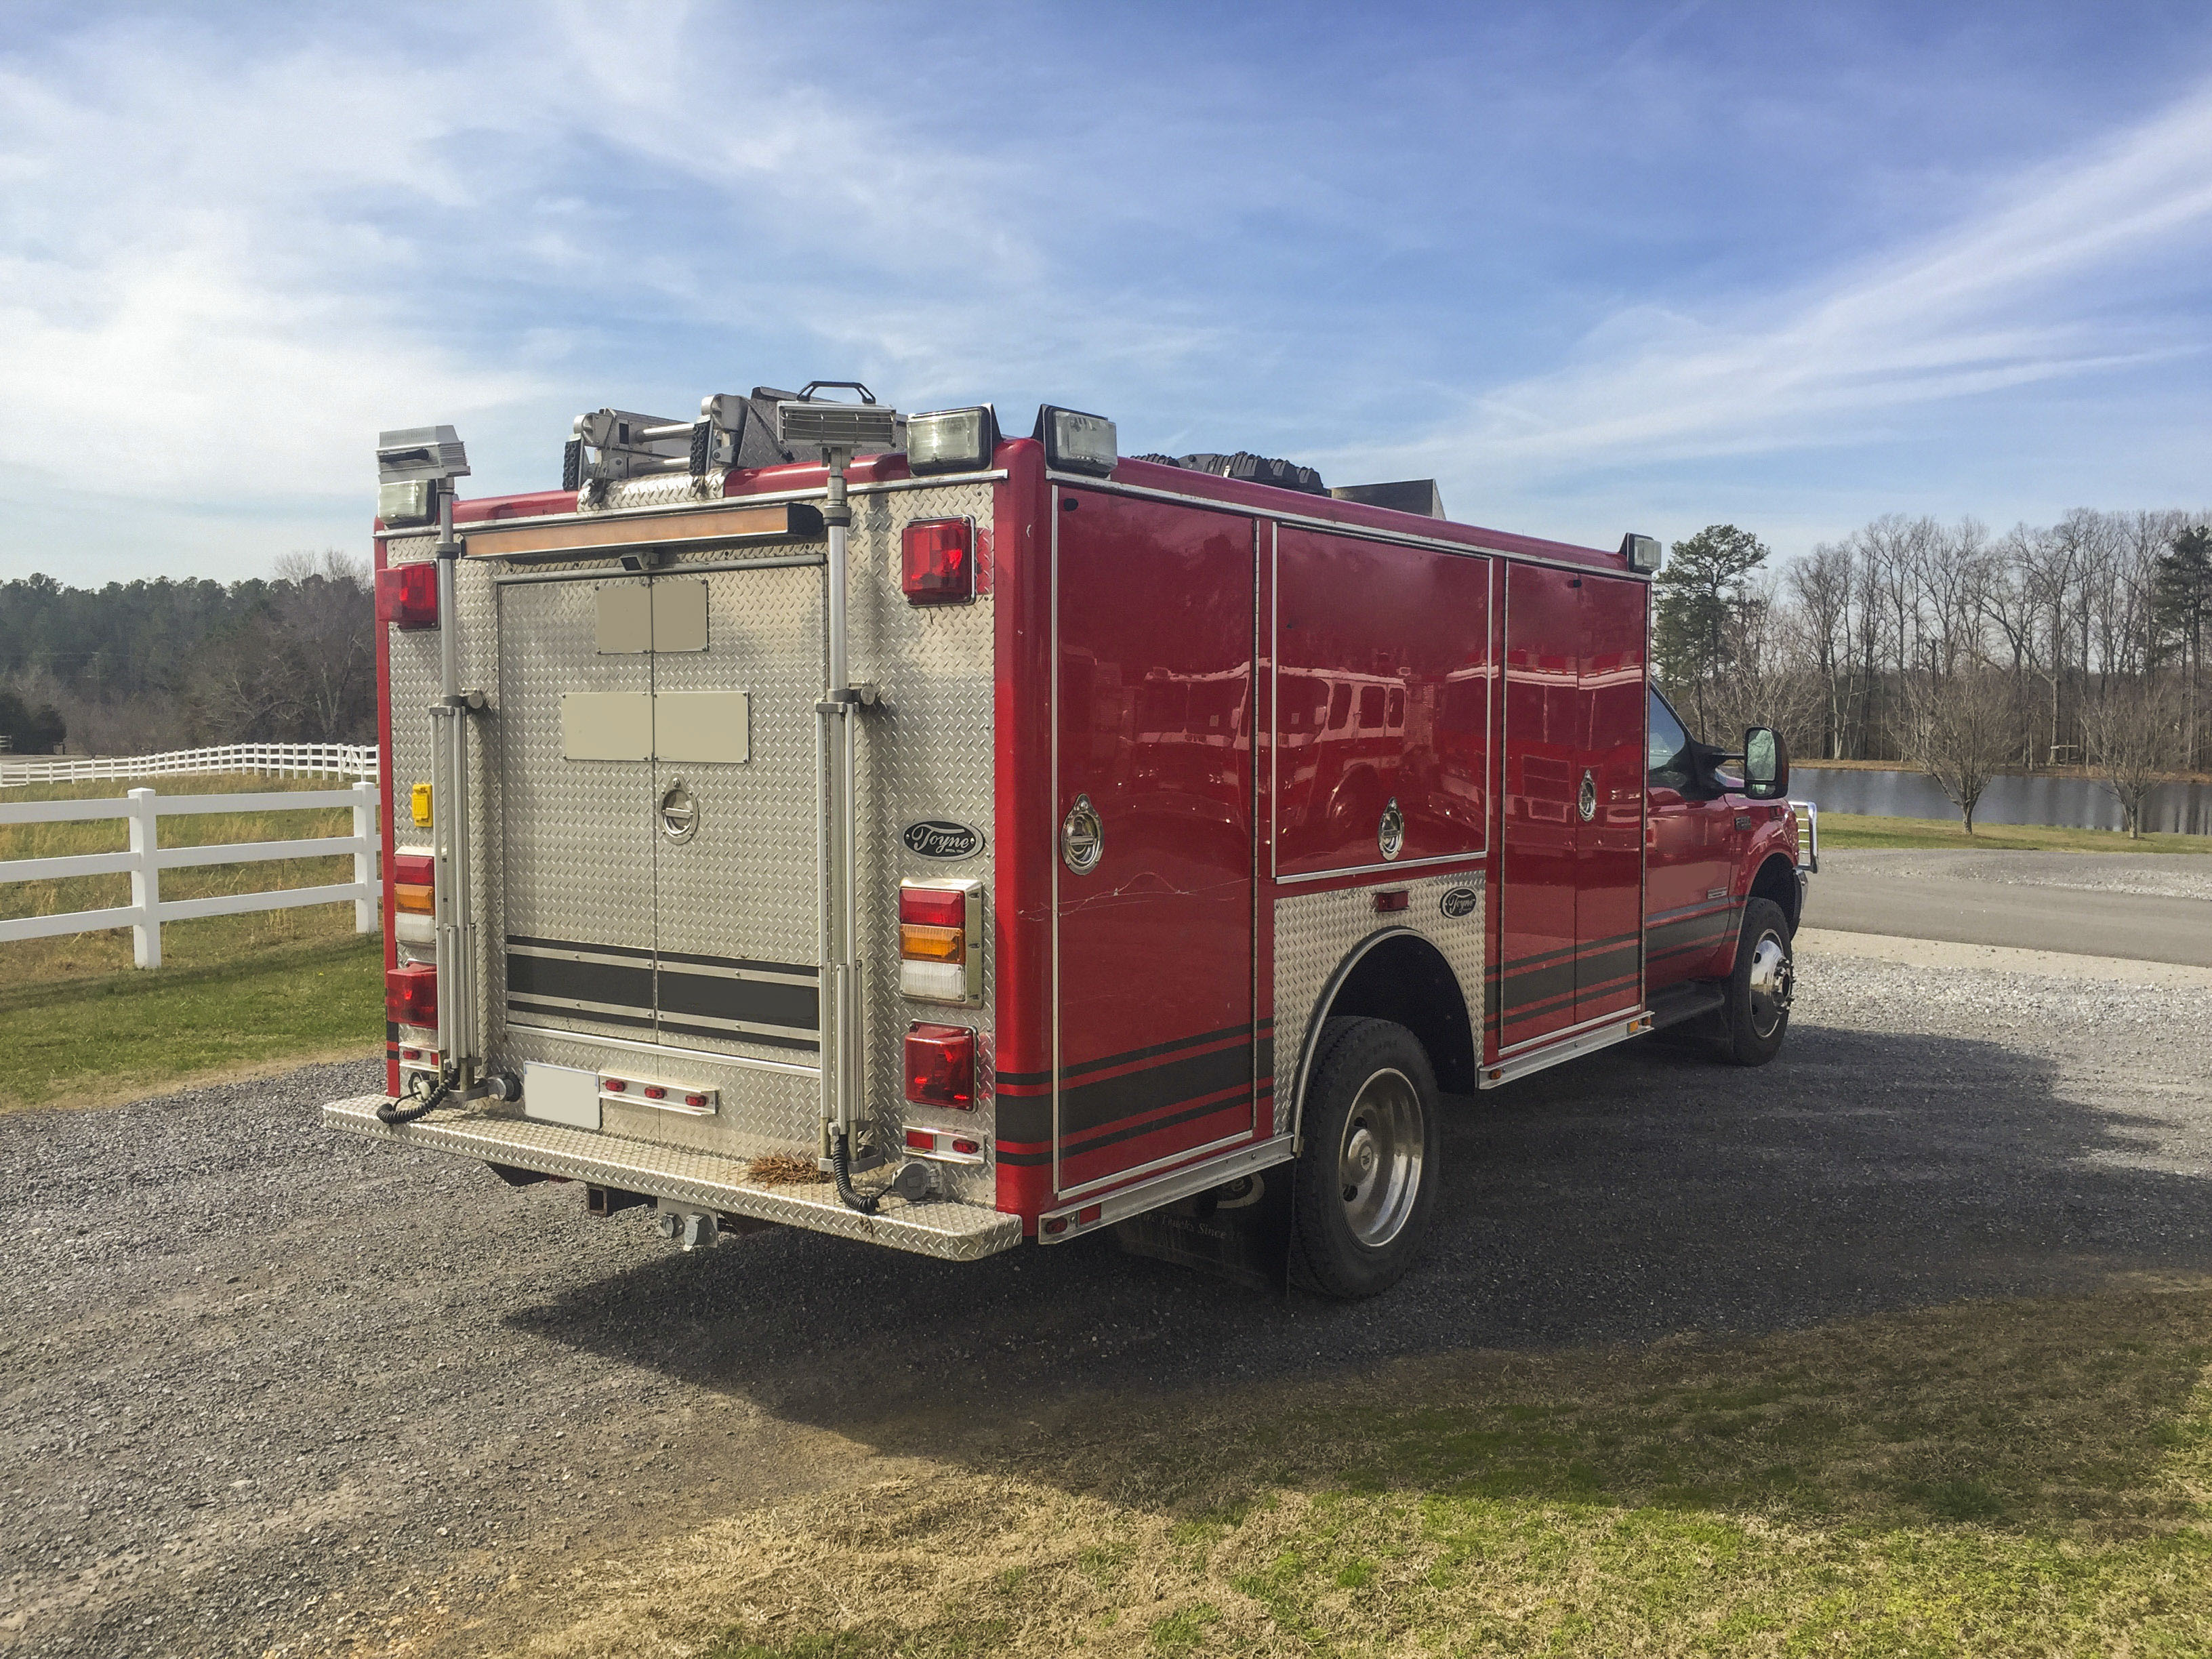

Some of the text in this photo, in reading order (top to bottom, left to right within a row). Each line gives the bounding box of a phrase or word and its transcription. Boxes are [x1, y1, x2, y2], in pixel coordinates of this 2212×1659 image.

[912, 823, 970, 854] Toyne
[1448, 893, 1473, 914] Toyne
[1197, 1223, 1227, 1239] Since
